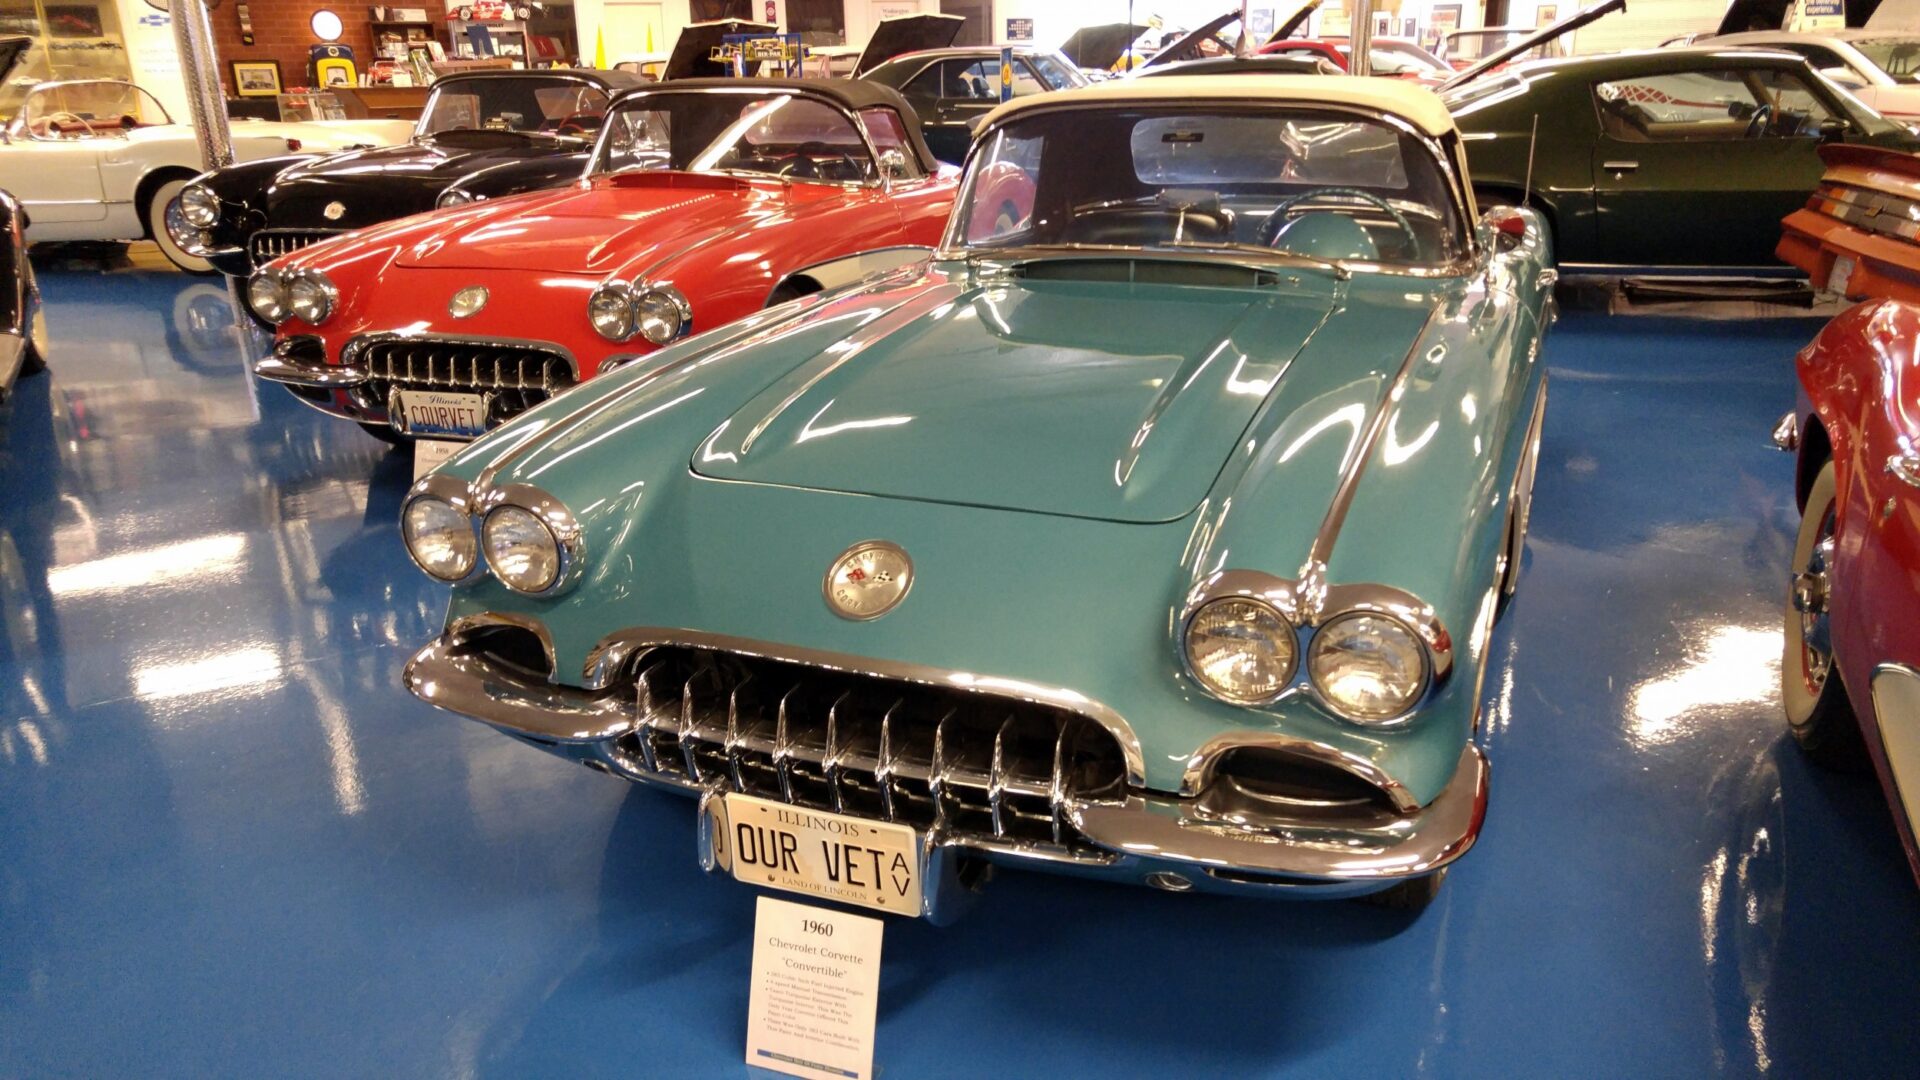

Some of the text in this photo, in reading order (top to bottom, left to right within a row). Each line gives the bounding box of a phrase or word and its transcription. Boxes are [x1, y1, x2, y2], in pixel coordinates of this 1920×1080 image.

[429, 395, 462, 405] Illinois
[411, 406, 476, 430] COURVET
[776, 809, 860, 837] ILLINOIS
[736, 822, 885, 890] OUR VET
[782, 876, 867, 901] LAND OF LINCOLN
[801, 919, 834, 937] 1960
[768, 937, 863, 965] Chevrolet Corvette
[782, 957, 848, 978] "Convertible"
